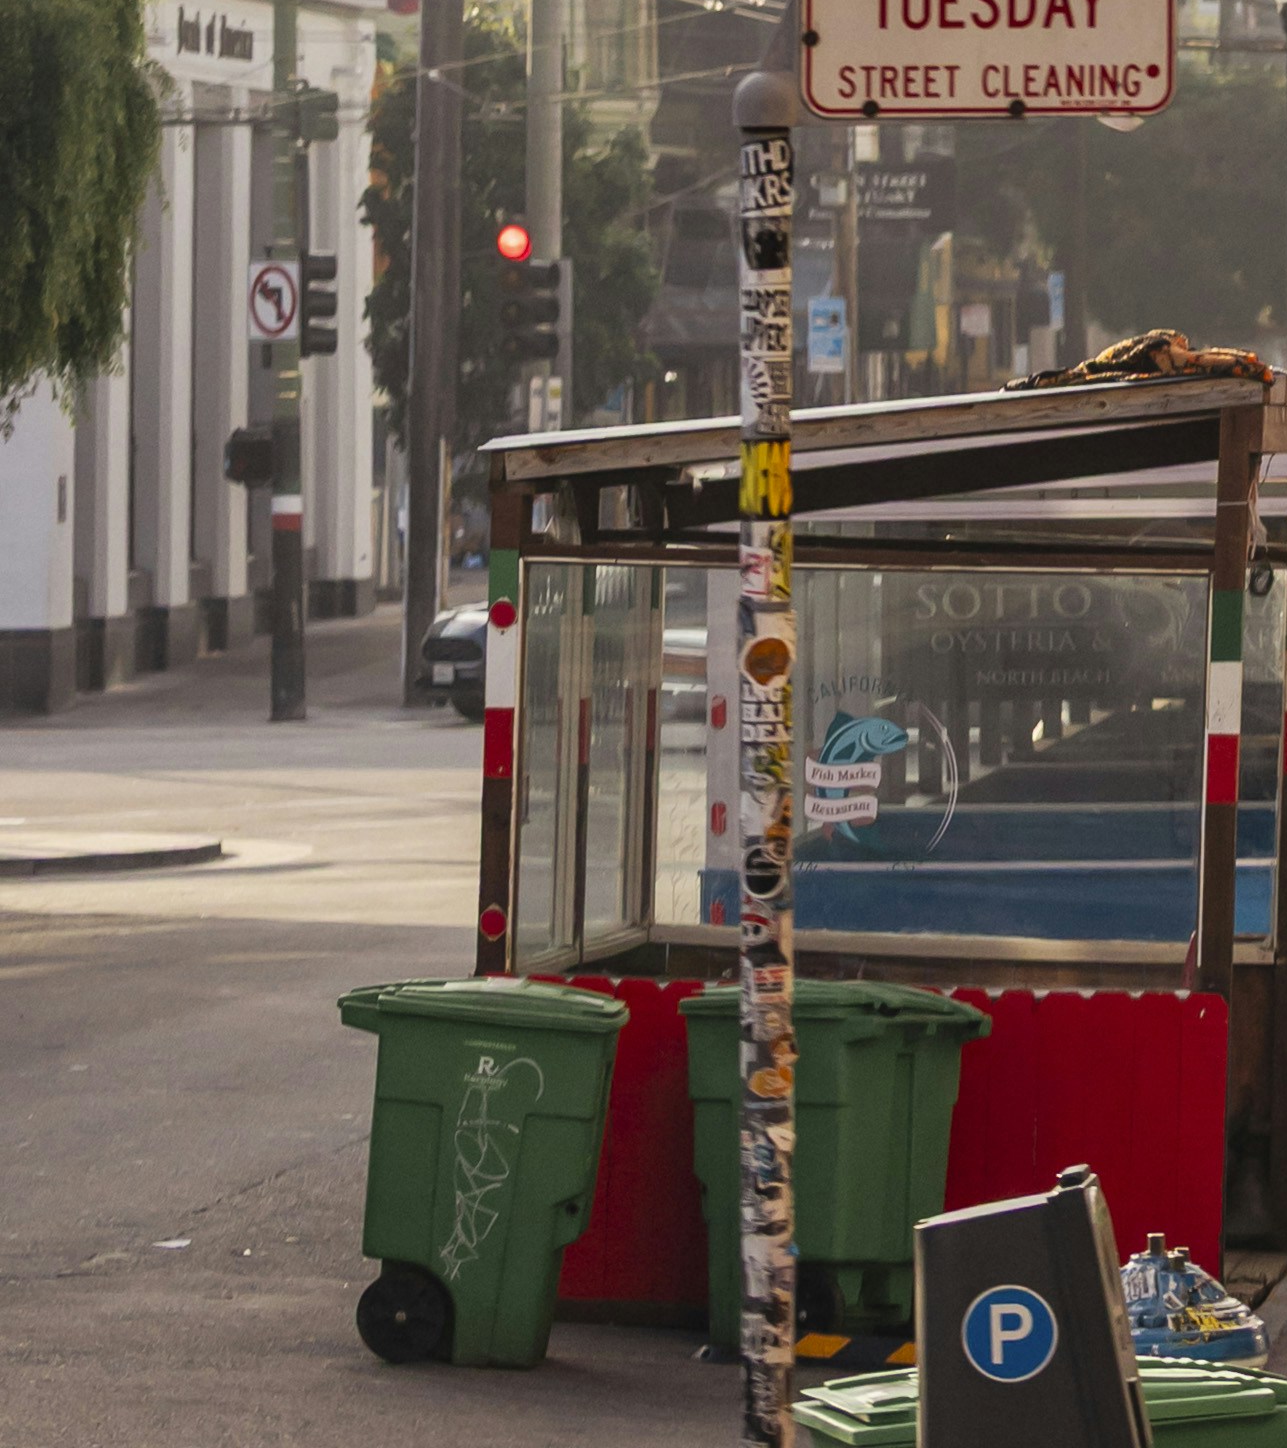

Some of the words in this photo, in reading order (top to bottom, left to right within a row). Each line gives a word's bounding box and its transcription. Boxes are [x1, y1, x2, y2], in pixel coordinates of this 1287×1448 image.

[837, 64, 961, 100] STREET
[980, 63, 1142, 99] CLEANING
[915, 583, 1092, 622] SOTTO
[930, 630, 1077, 654] OYSTERIA
[811, 767, 834, 782] Fish
[836, 767, 878, 782] Market
[810, 800, 872, 816] Restaurant
[990, 1304, 1034, 1365] P
